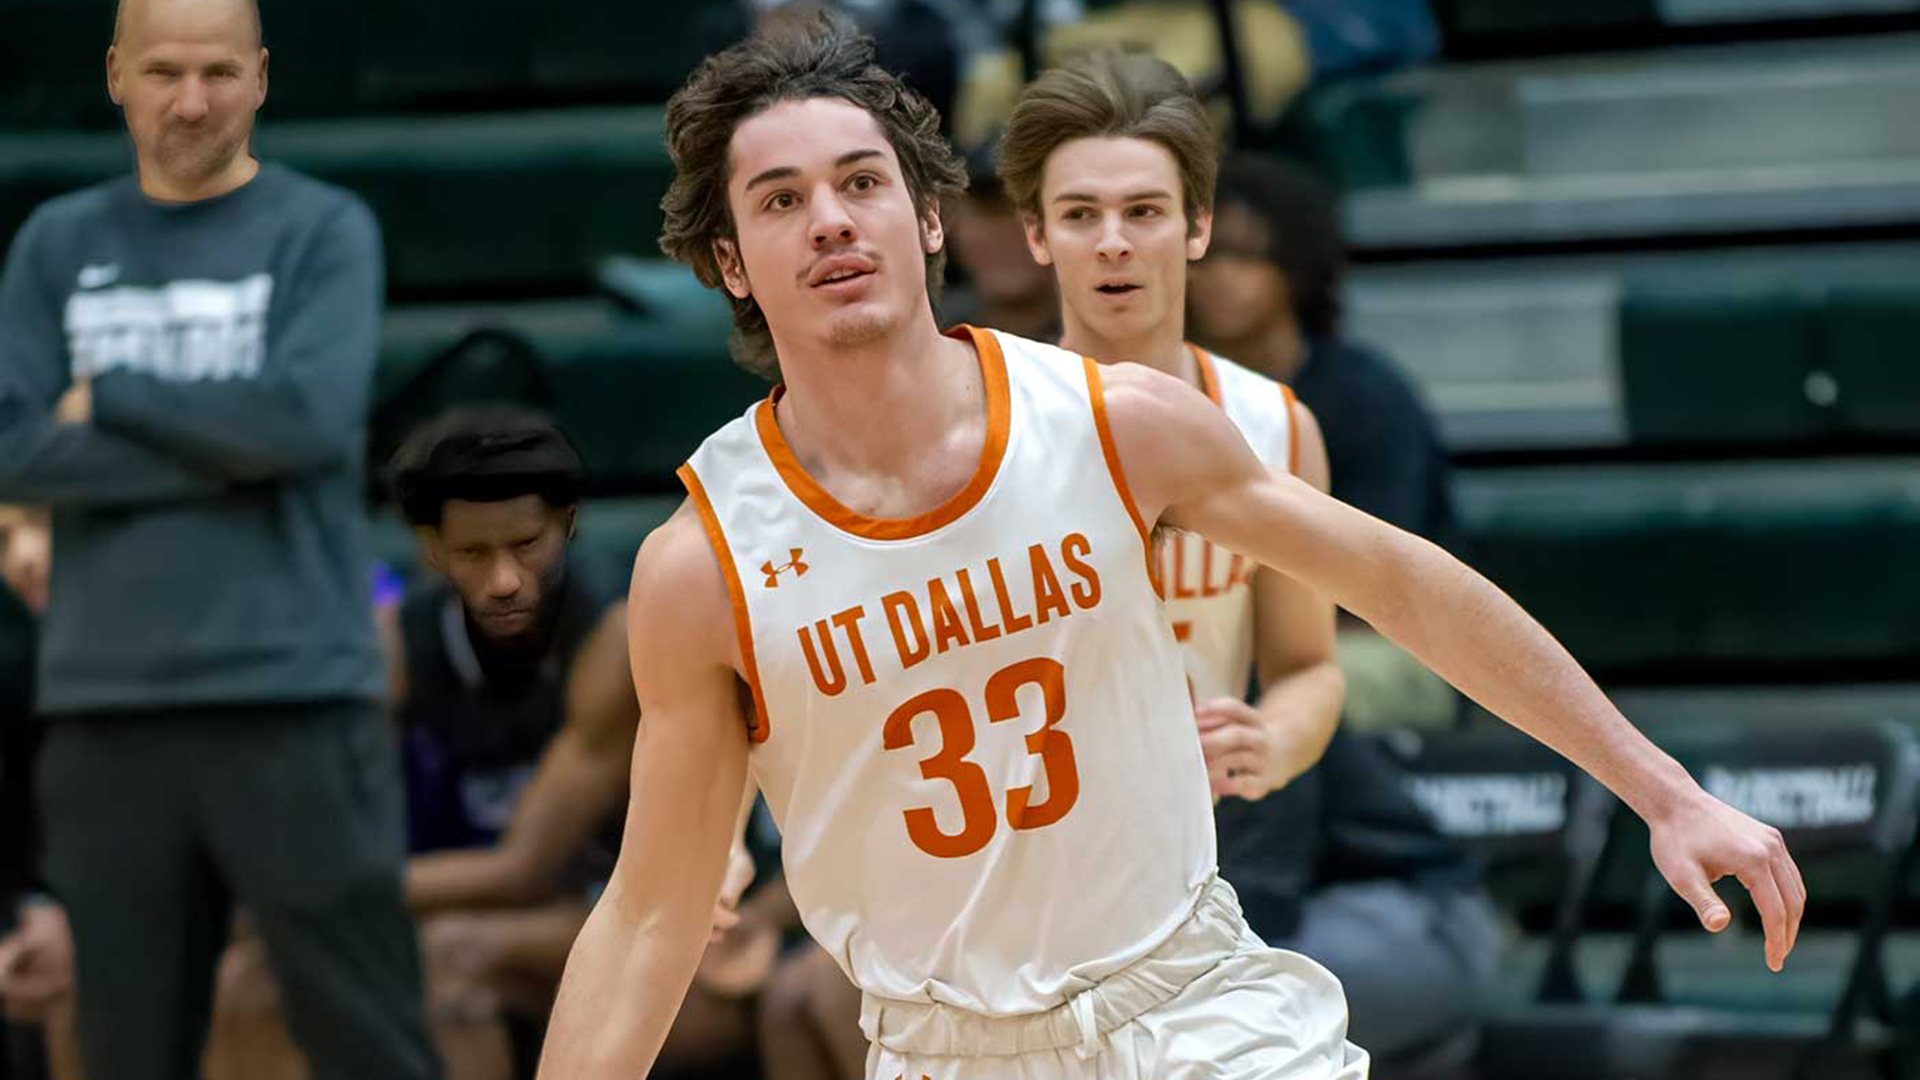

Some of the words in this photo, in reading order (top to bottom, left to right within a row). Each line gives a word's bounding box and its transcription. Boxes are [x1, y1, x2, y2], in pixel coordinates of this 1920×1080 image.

[797, 605, 877, 697] UT
[881, 532, 1102, 670] DALLAS
[883, 657, 1080, 859] 33
